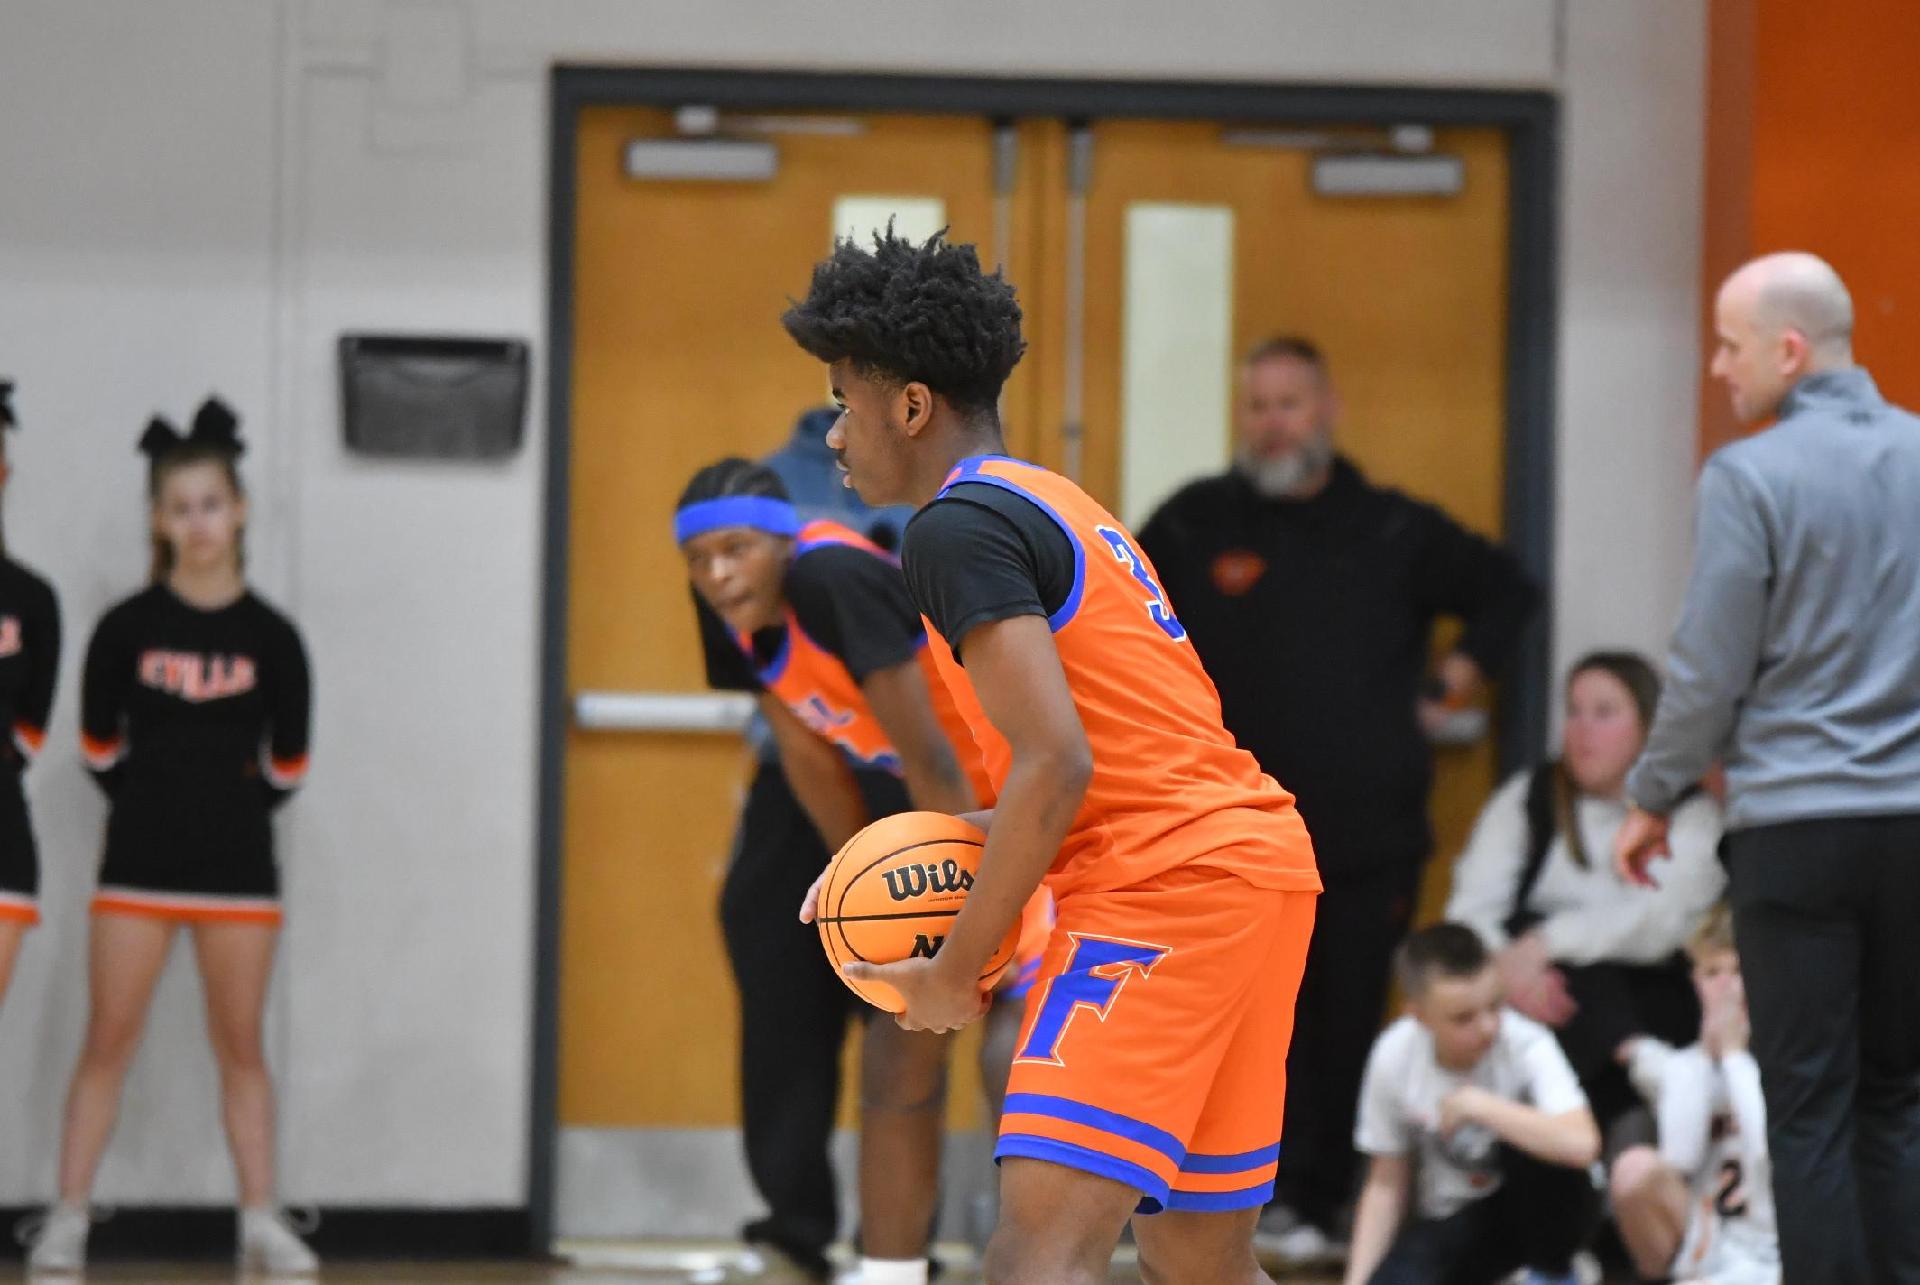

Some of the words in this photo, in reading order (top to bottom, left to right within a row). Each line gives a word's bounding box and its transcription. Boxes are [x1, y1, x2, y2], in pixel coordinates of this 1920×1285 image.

[1095, 525, 1186, 642] 3
[881, 858, 975, 902] Wils
[1012, 931, 1173, 1067] F
[1715, 1158, 1748, 1217] 2
